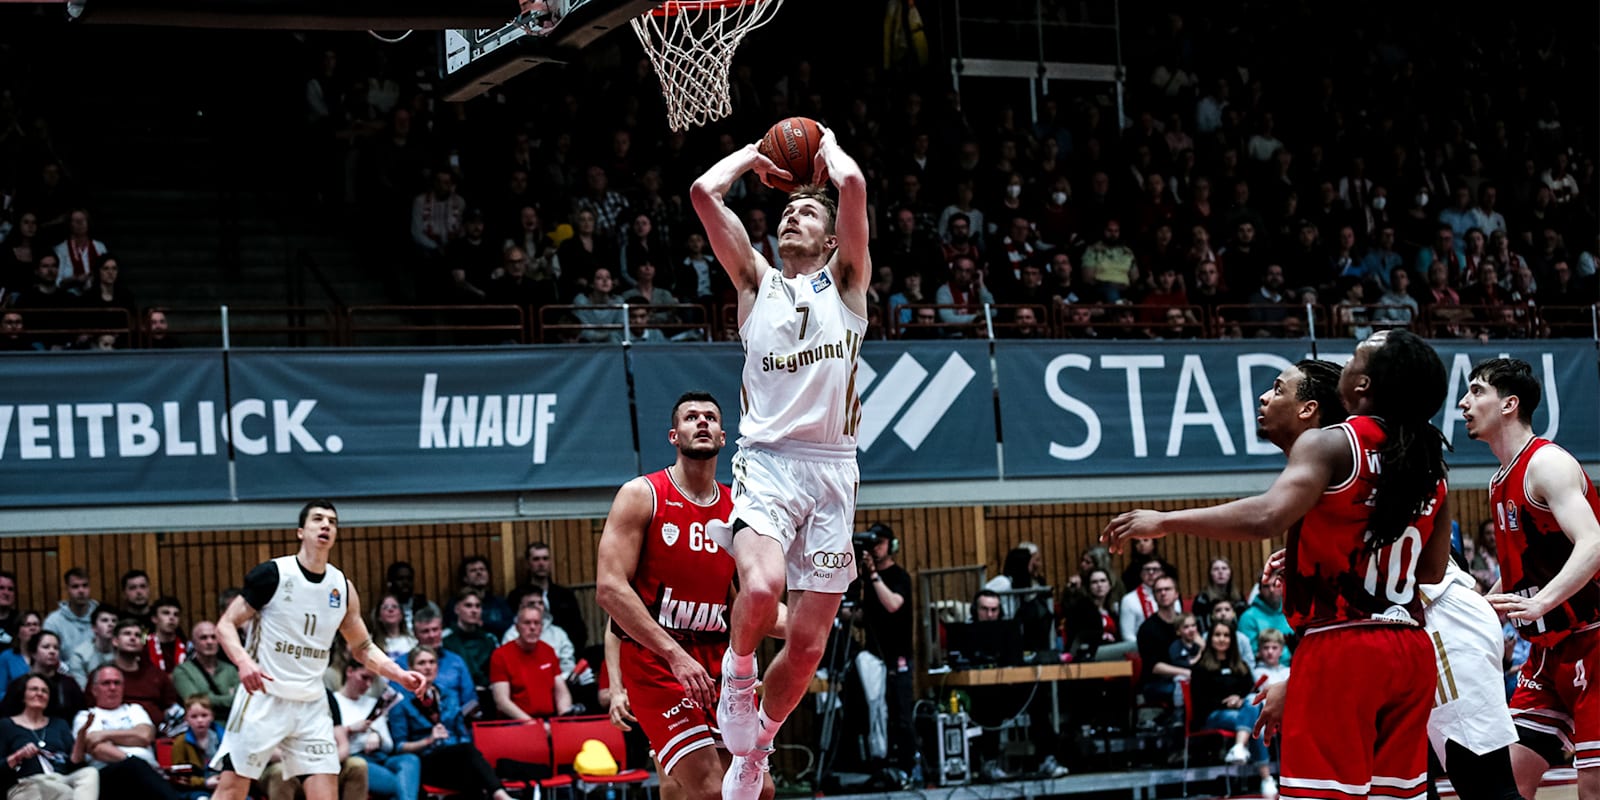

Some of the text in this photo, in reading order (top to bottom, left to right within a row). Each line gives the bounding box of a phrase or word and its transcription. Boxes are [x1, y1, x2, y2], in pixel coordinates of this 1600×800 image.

[795, 305, 810, 340] 7
[762, 341, 844, 373] siegmund
[1045, 352, 1560, 460] STADAU
[0, 398, 343, 460] EITBLICK.
[689, 521, 719, 554] 65
[813, 571, 833, 579] Audi
[304, 613, 317, 636] 11
[275, 640, 328, 660] siegmun
